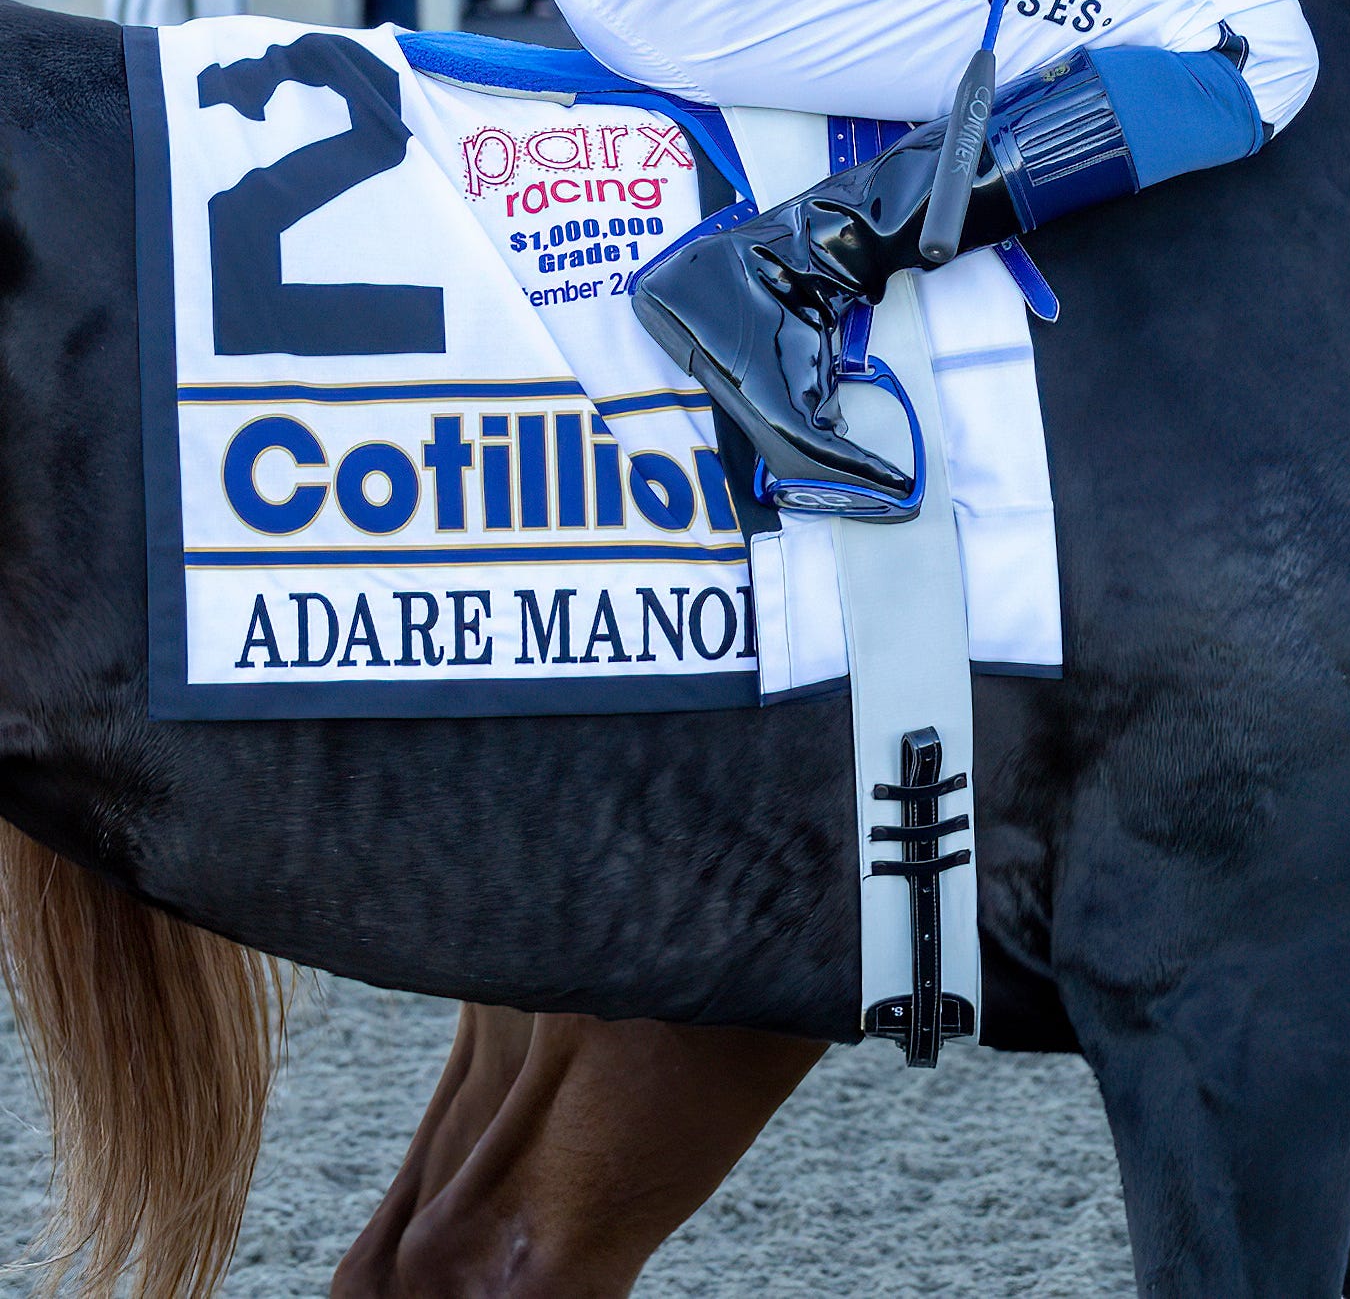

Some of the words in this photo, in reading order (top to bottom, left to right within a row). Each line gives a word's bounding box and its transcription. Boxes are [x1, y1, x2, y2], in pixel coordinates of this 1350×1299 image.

[460, 124, 696, 200] parx
[196, 32, 448, 356] 2
[506, 177, 665, 218] racing
[510, 216, 664, 253] $1,000,000
[538, 242, 621, 274] Grade
[625, 241, 640, 261] 1
[522, 279, 604, 307] ember
[234, 589, 493, 668] ADARE
